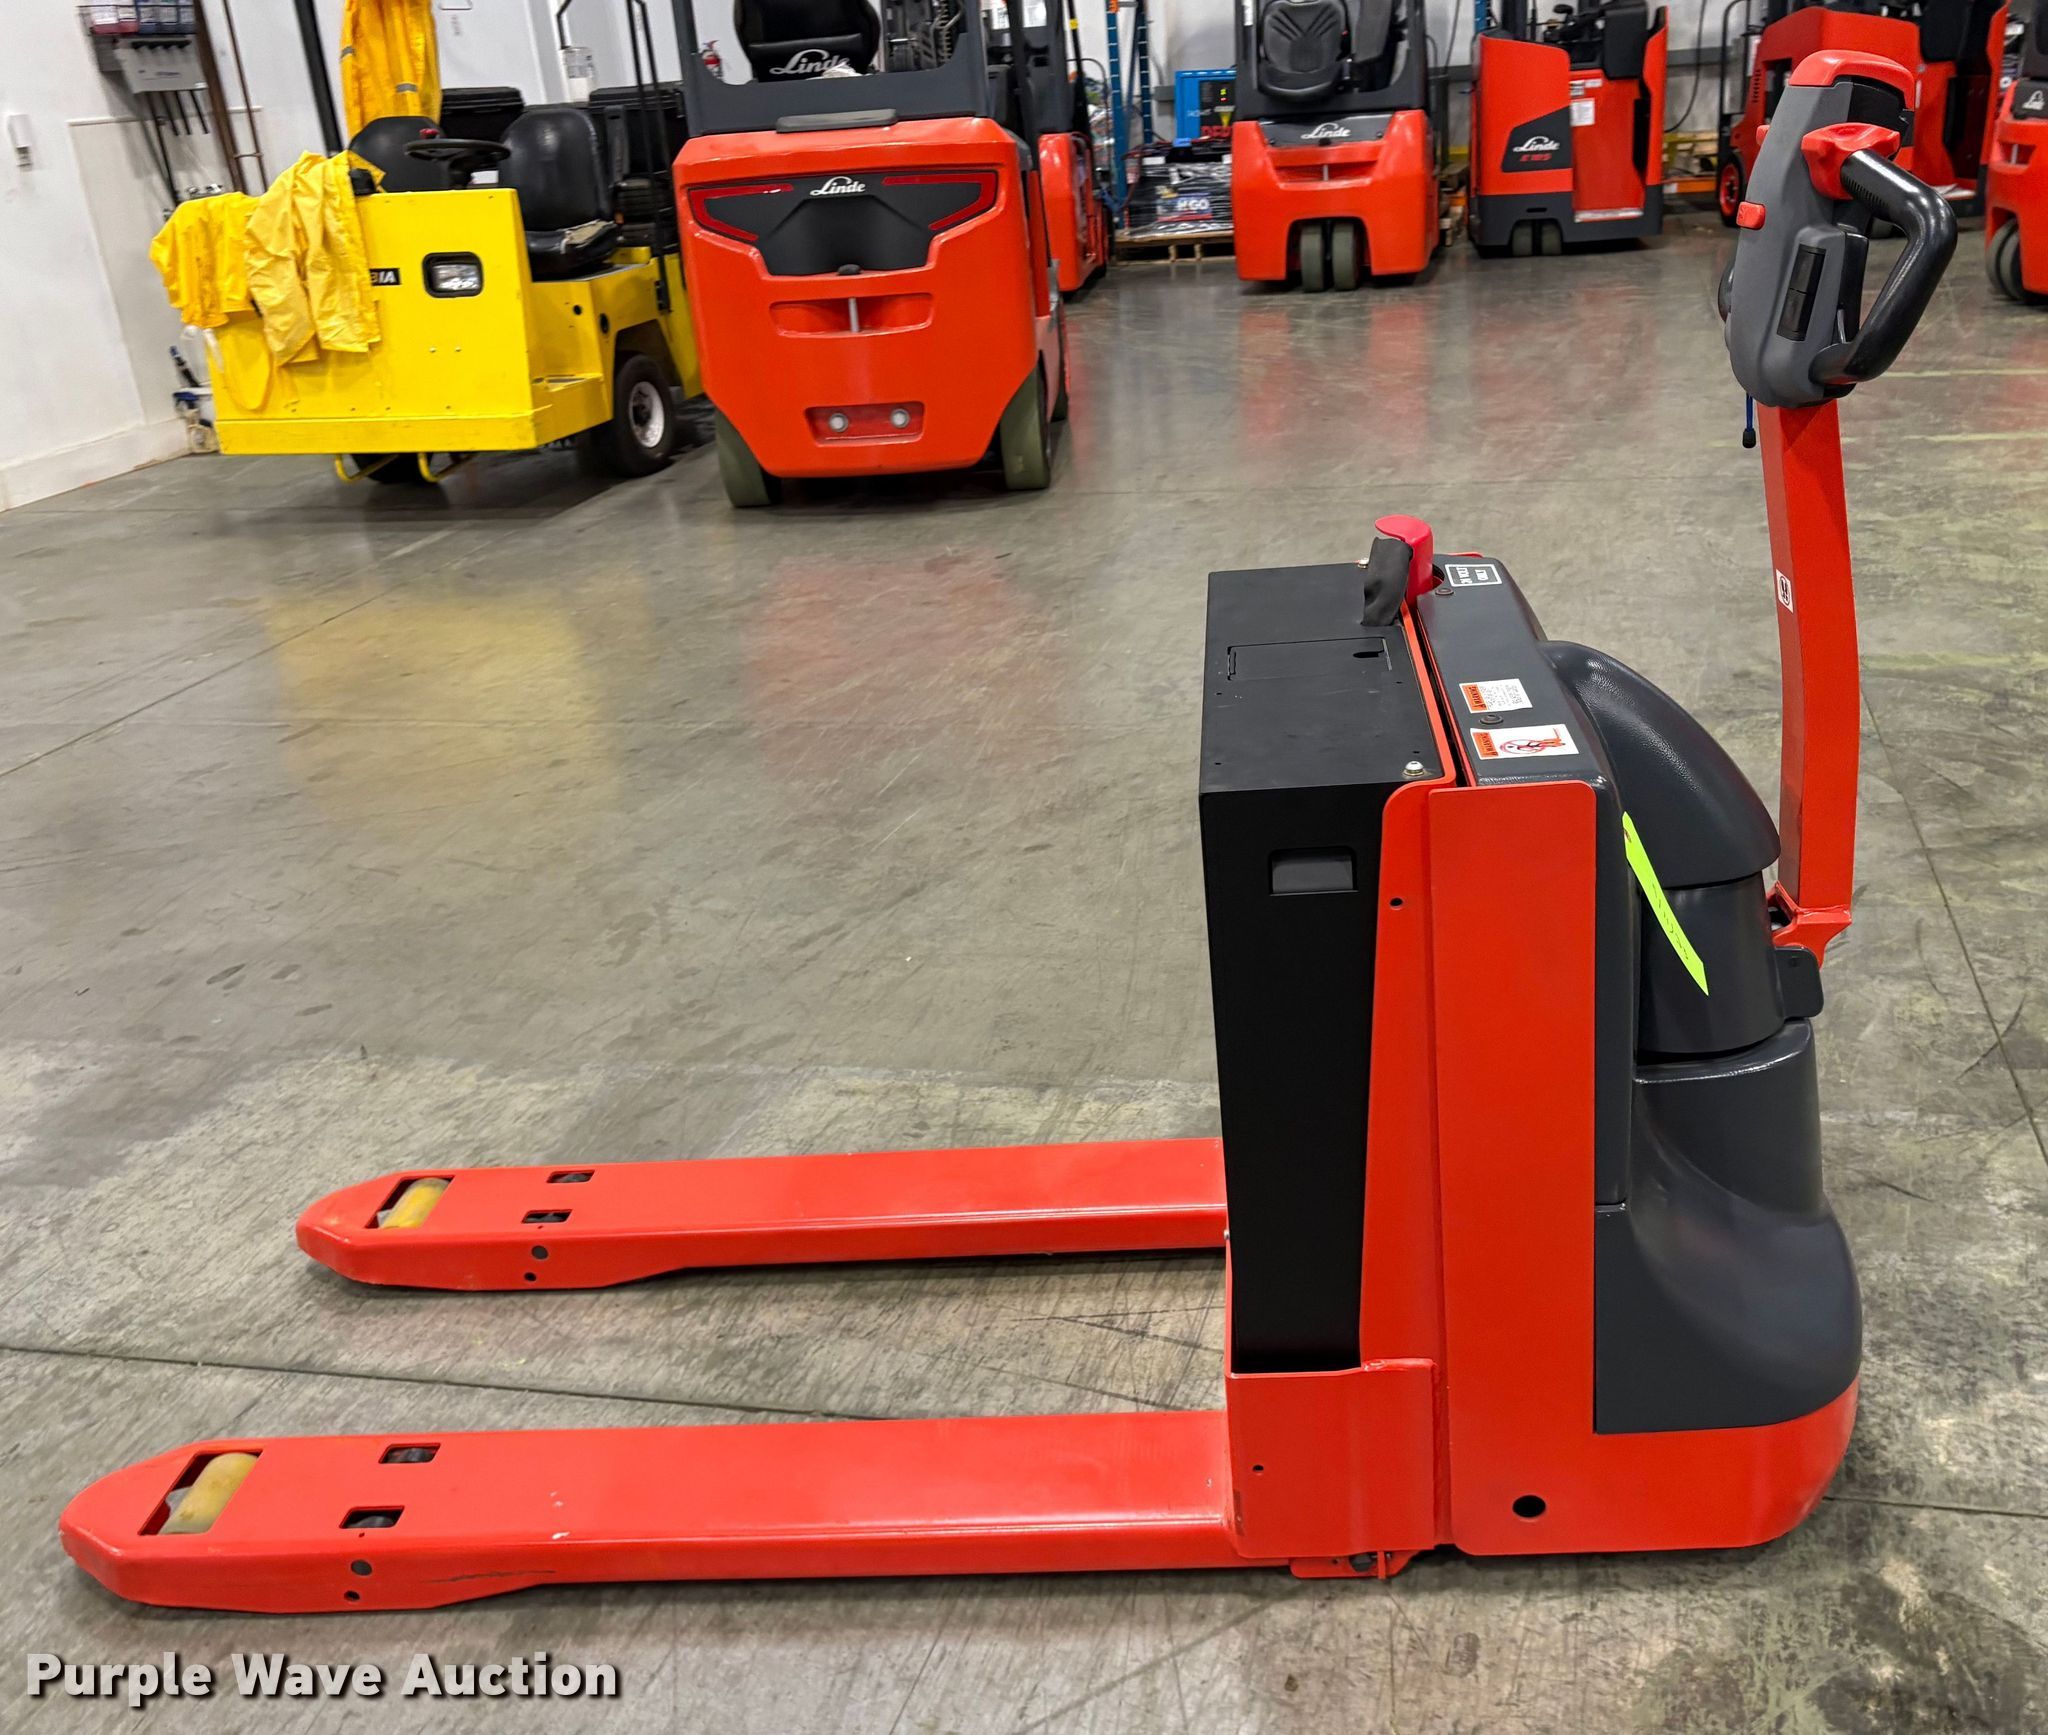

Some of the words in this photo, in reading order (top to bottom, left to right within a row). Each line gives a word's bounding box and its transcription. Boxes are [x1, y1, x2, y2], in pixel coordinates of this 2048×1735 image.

[1301, 122, 1351, 139] Linde
[1513, 136, 1560, 152] Linde
[810, 176, 866, 195] Linde
